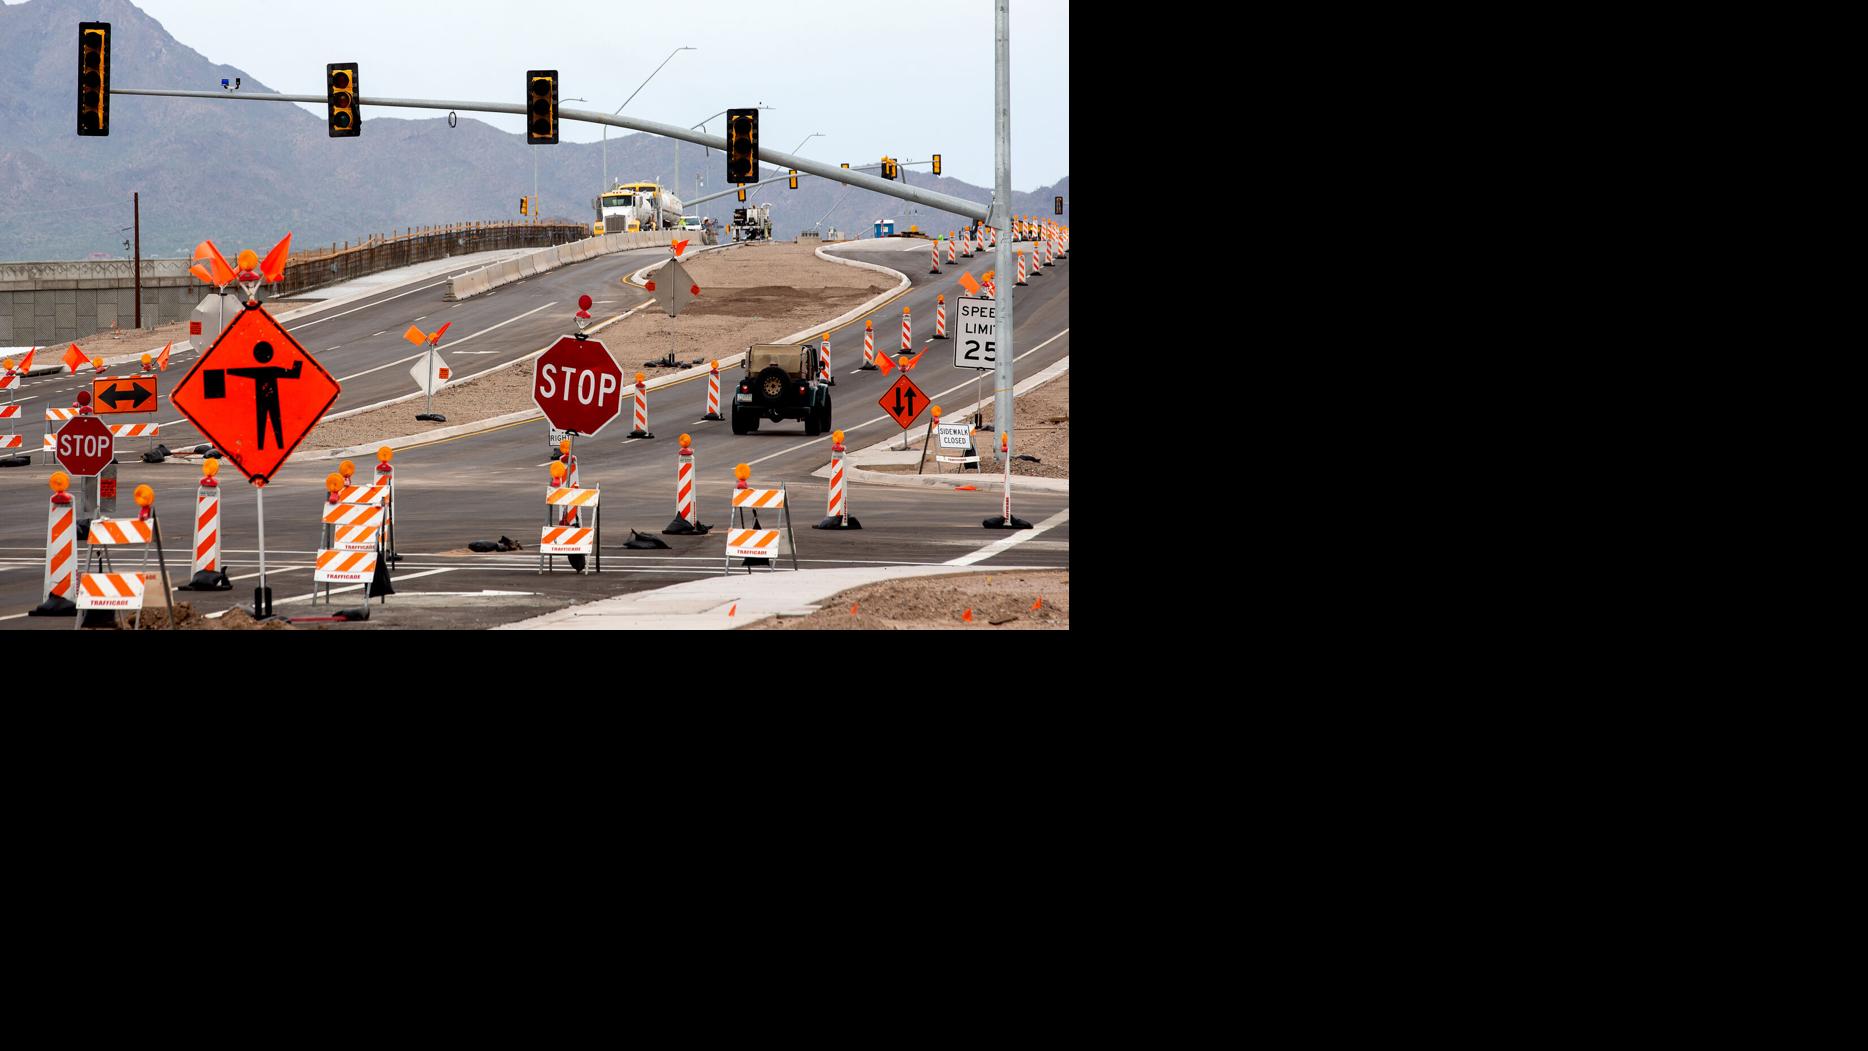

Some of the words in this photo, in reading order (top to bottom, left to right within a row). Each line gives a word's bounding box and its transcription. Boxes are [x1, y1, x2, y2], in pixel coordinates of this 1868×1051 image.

[961, 305, 995, 319] SPEE
[965, 322, 995, 335] LIMI
[964, 340, 995, 362] 25
[539, 363, 617, 408] STOP
[550, 434, 570, 442] RIGHT
[939, 427, 969, 436] SIDEWALK
[59, 434, 110, 458] STOP
[943, 437, 967, 445] CLOSED
